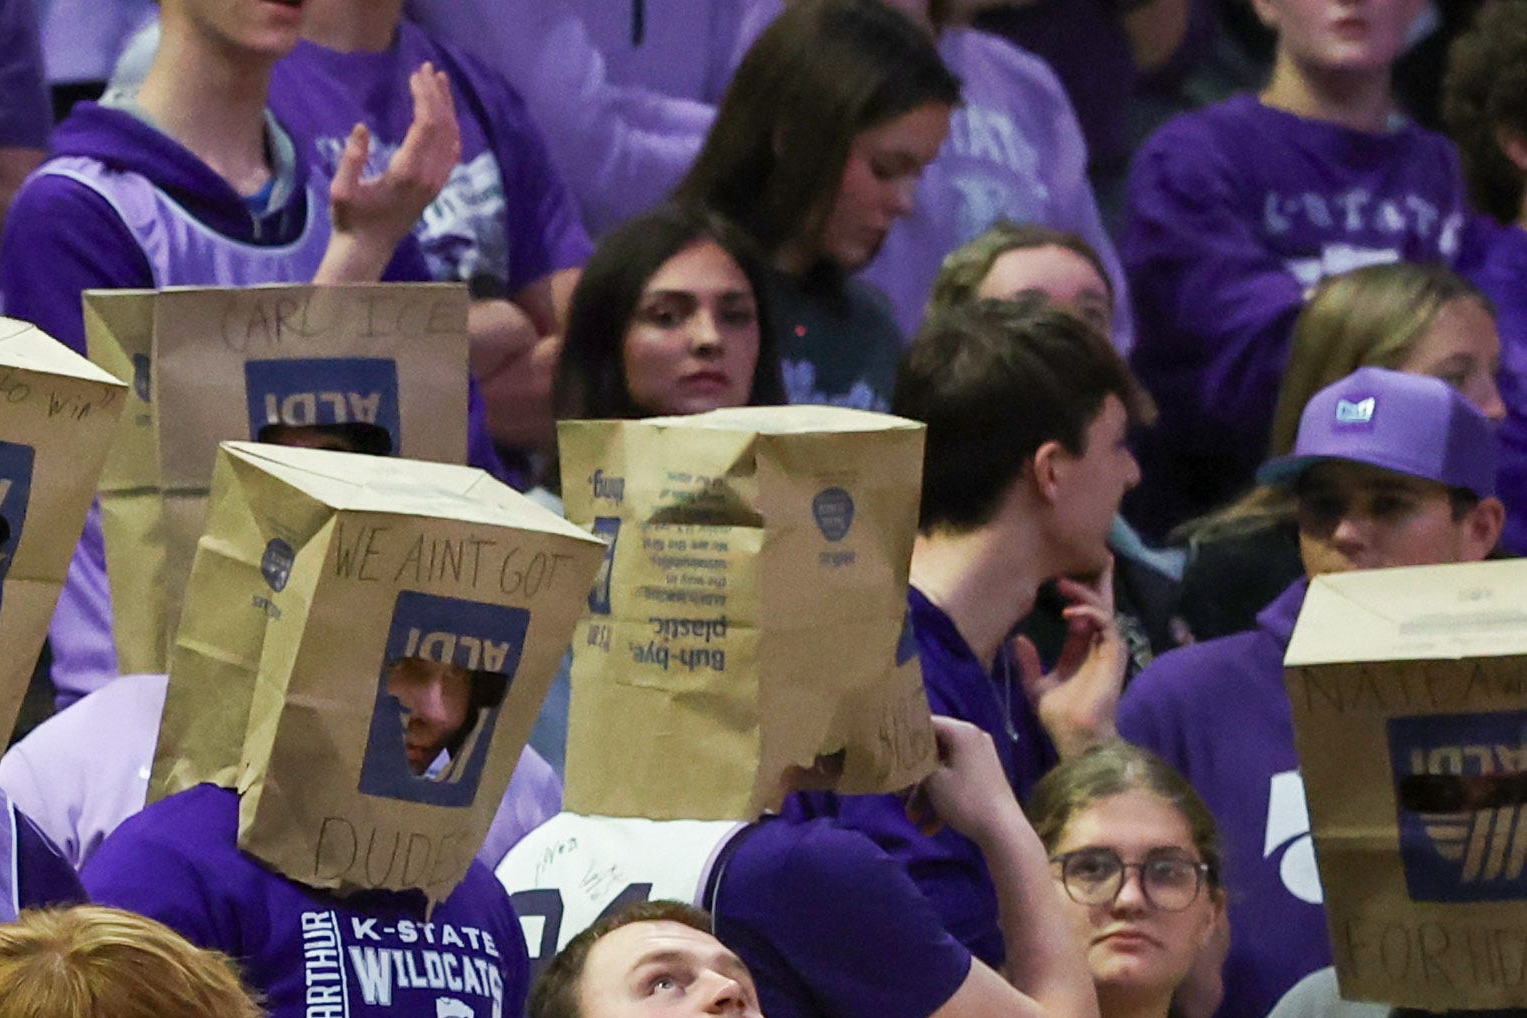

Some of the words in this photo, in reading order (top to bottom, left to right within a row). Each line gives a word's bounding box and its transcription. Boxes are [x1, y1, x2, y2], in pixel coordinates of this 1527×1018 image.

[222, 297, 324, 351] CARL
[265, 391, 381, 426] ALDI
[335, 521, 388, 582] WE
[394, 534, 496, 588] AINT
[499, 547, 575, 598] GOT
[405, 628, 510, 673] ALDI
[629, 640, 726, 671] Buh-bye,
[314, 815, 467, 890] DUDE
[351, 916, 500, 959] K-STATE
